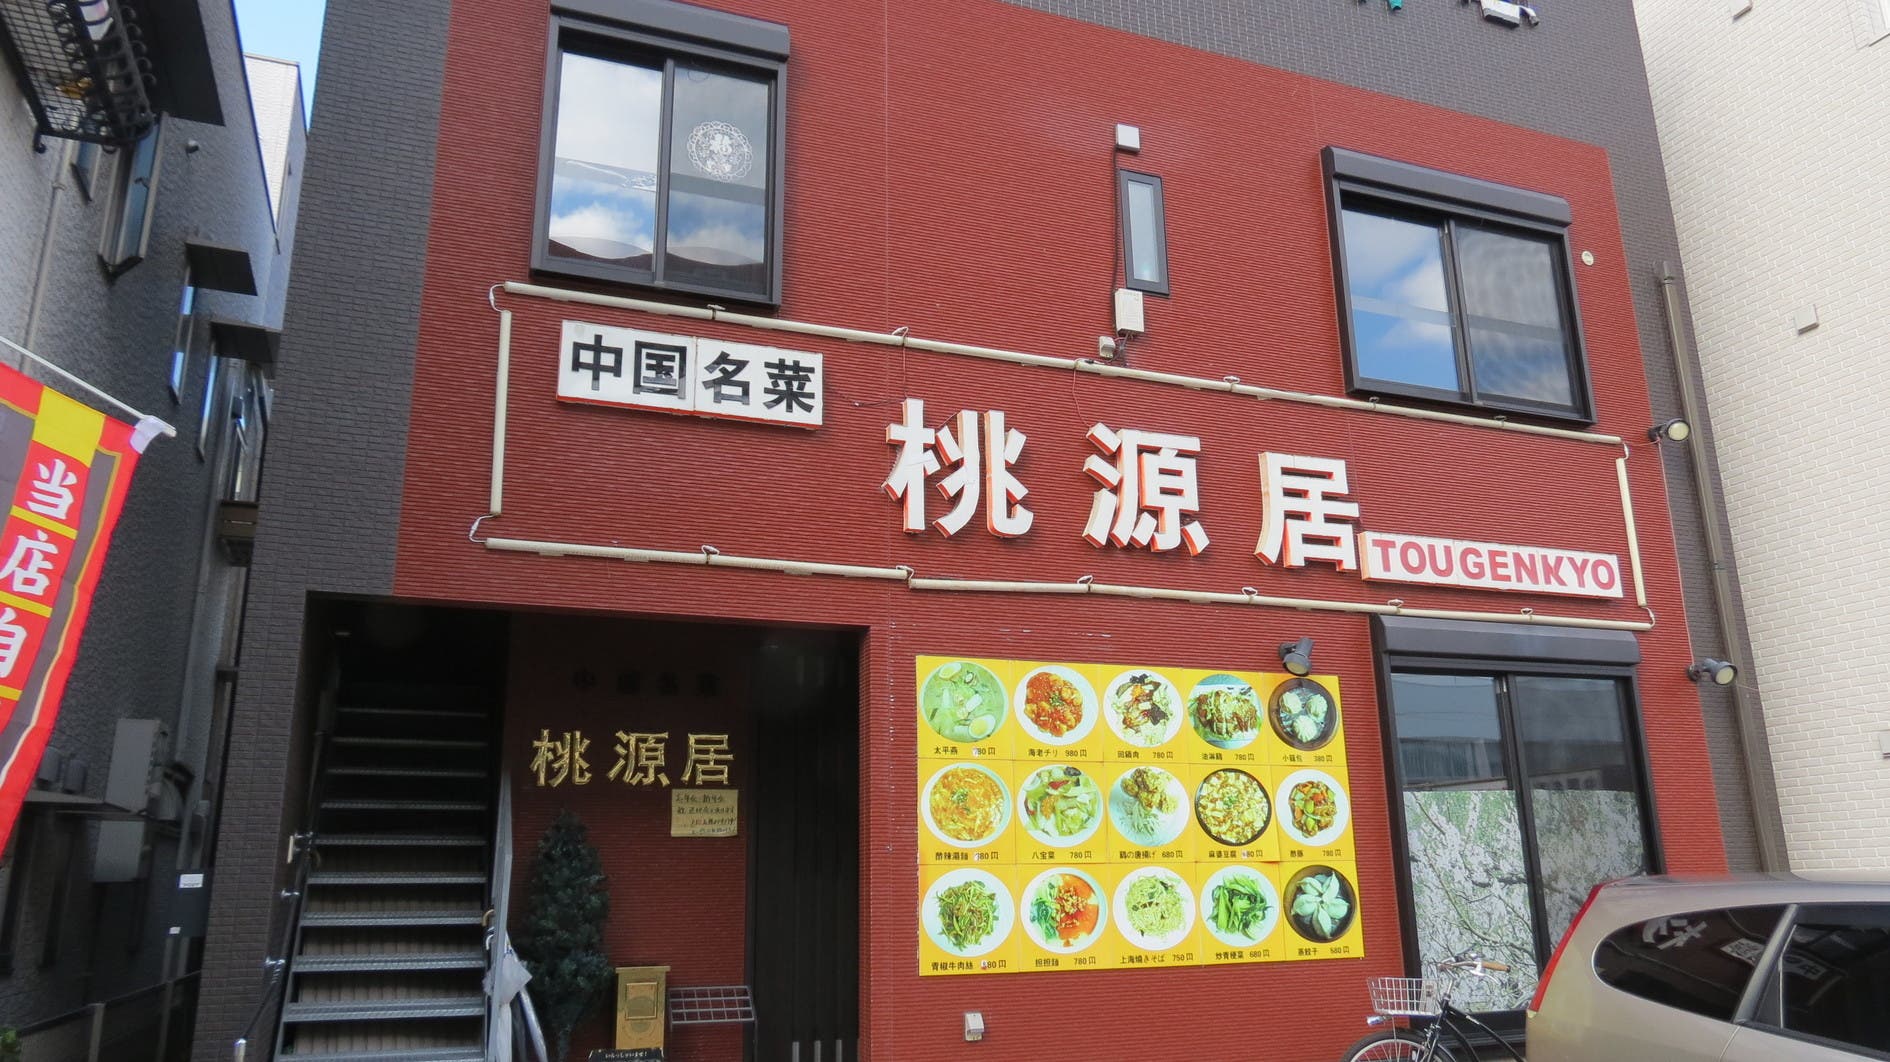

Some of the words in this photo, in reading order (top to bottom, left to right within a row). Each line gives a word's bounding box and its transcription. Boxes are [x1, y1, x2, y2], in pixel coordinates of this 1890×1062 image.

[572, 334, 815, 413] 中国名菜
[881, 397, 1360, 572] 桃源居
[1371, 539, 1615, 590] TOUGENKYO
[530, 729, 734, 787] 桃源居
[1028, 748, 1058, 757] 海老チリ
[1032, 851, 1055, 860] 八宝菜
